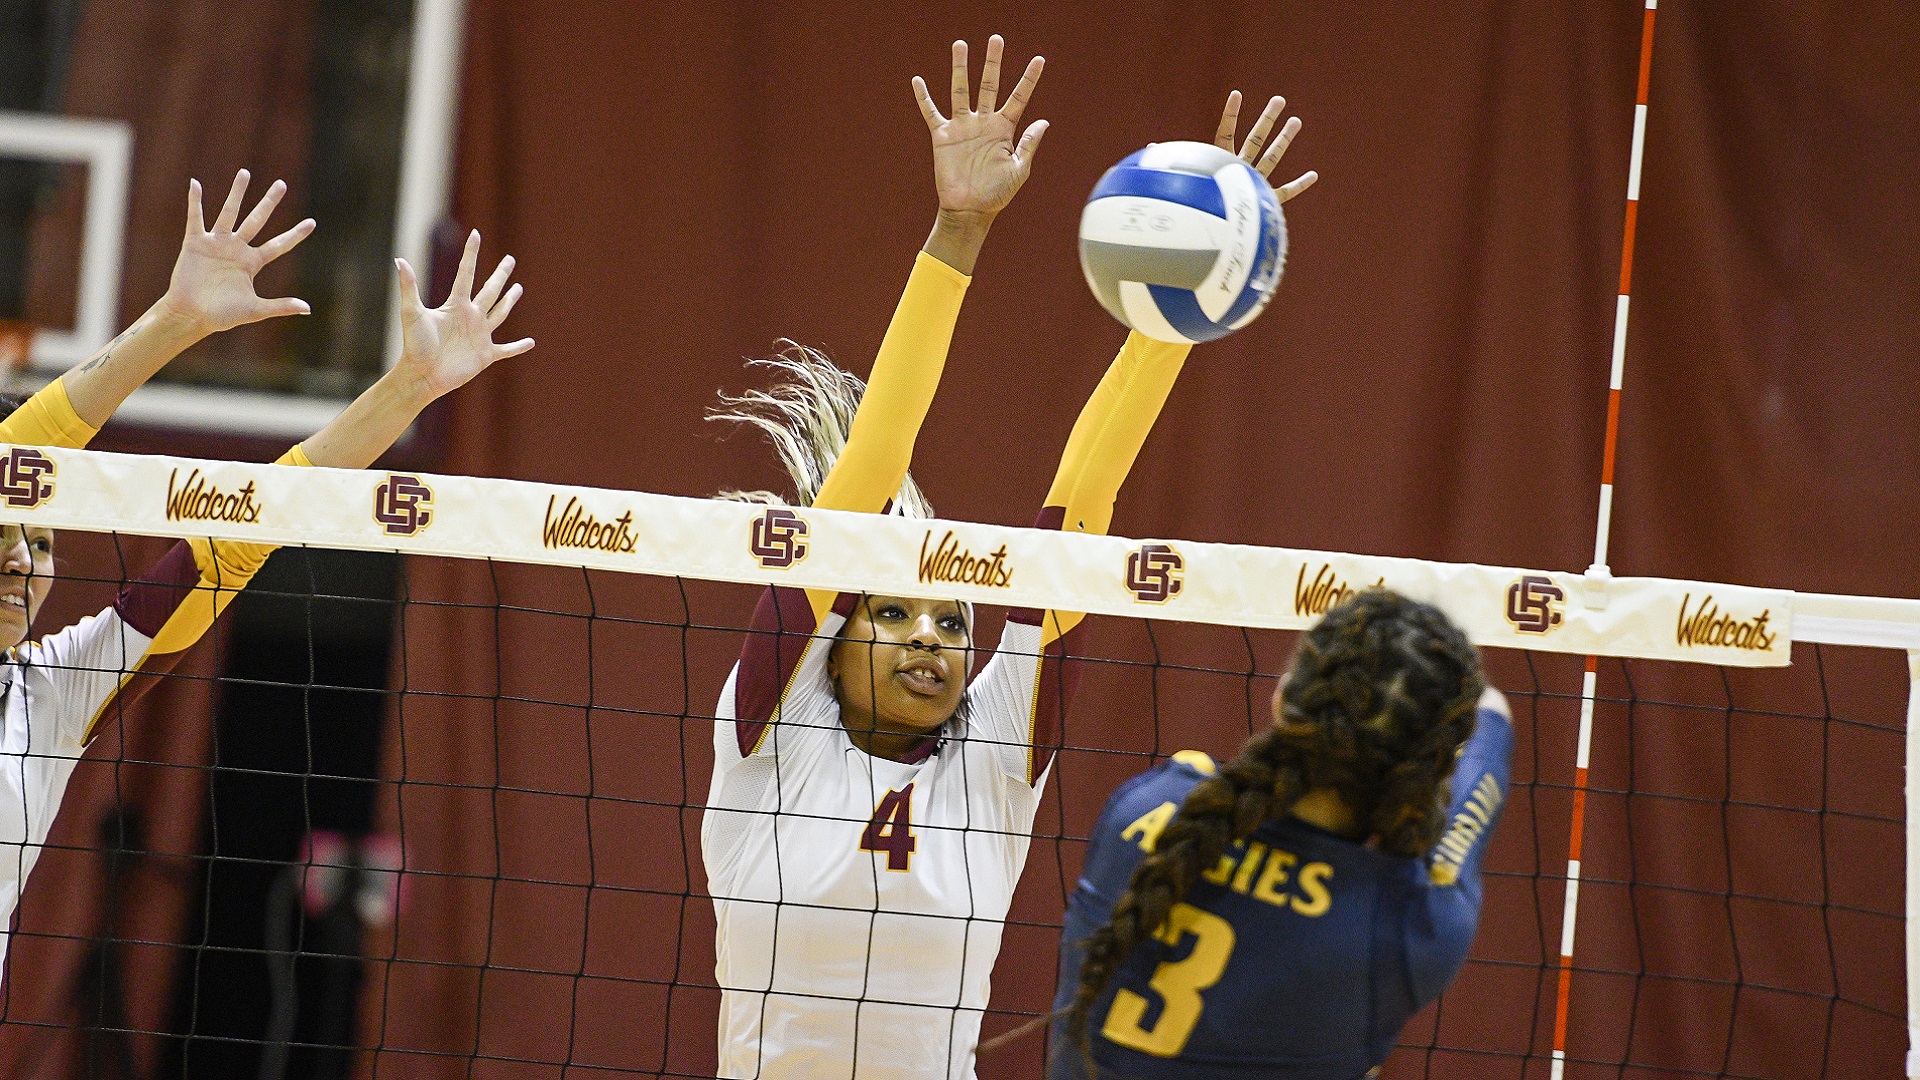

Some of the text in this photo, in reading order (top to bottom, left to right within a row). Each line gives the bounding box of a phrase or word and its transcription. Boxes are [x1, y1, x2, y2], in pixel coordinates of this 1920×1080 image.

[166, 467, 262, 523] Wildcats
[542, 494, 638, 554] Wildcats
[918, 529, 1012, 588] Wildcats
[1295, 562, 1385, 615] Wild
[1676, 593, 1775, 651] Wildcats
[858, 782, 917, 872] 4
[1102, 902, 1236, 1058] 3
